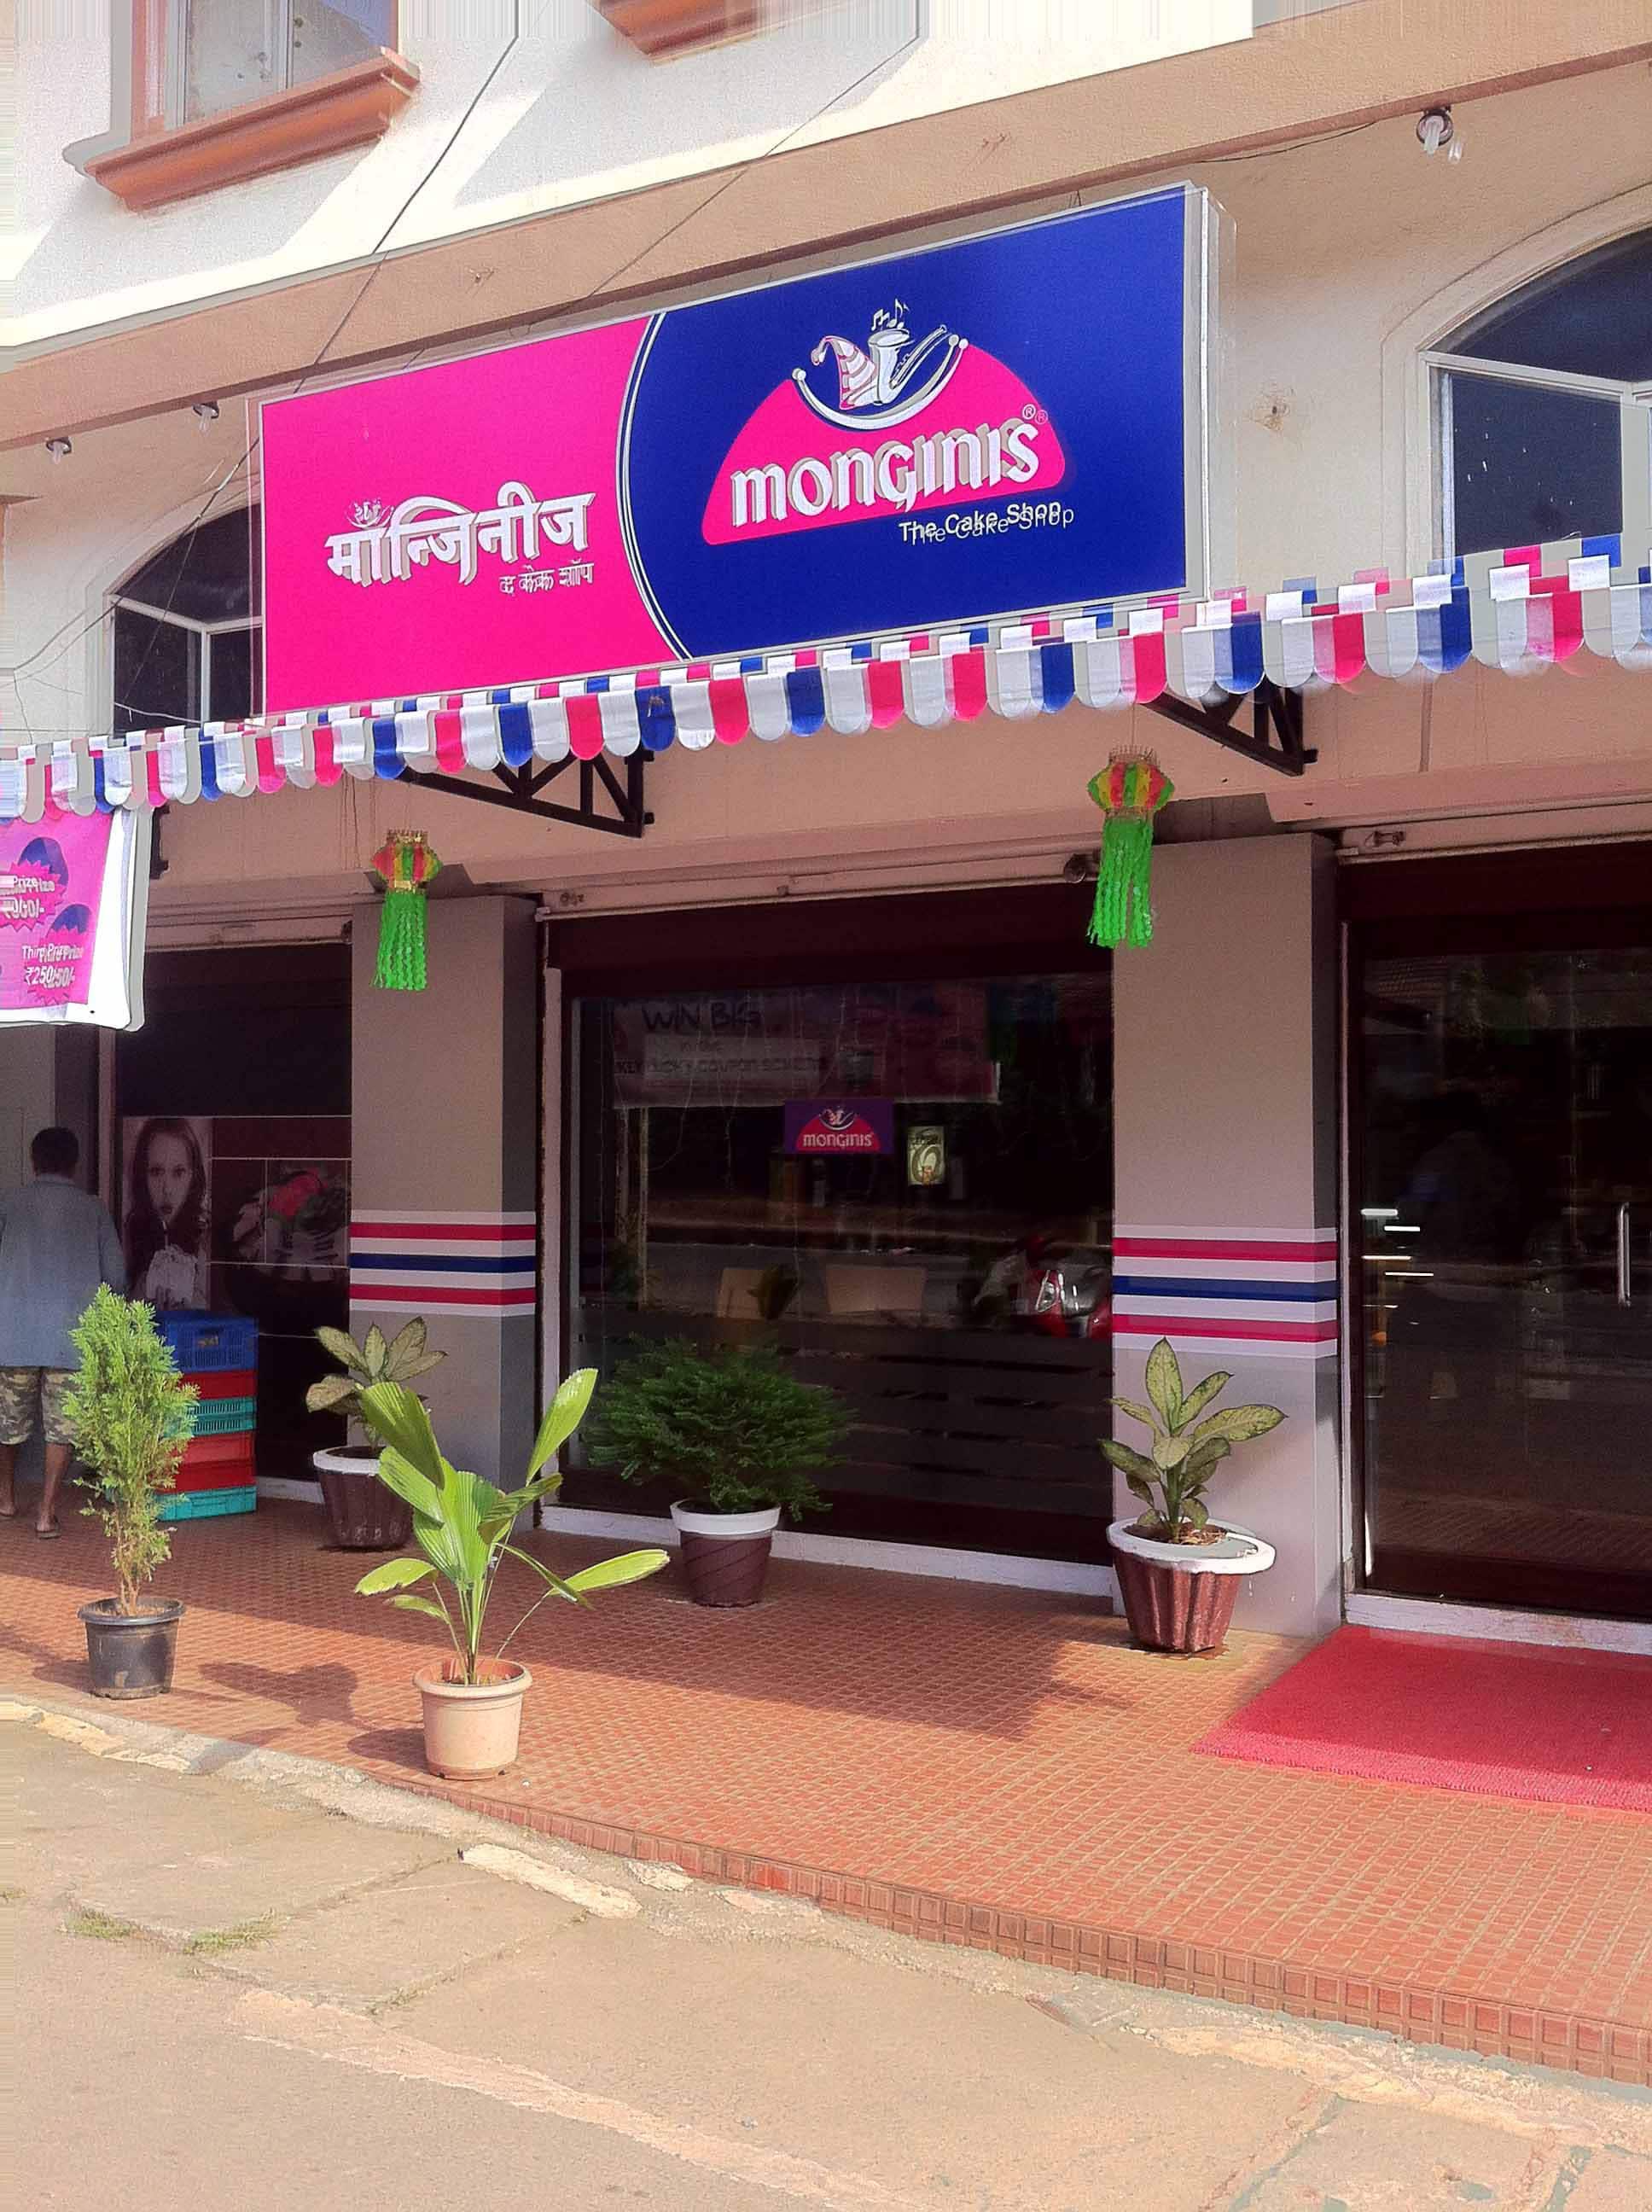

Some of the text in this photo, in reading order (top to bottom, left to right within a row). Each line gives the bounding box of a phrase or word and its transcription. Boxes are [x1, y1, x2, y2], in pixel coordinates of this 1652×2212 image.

[899, 500, 1073, 544] The Cake Shop
[642, 1001, 701, 1031] WIN
